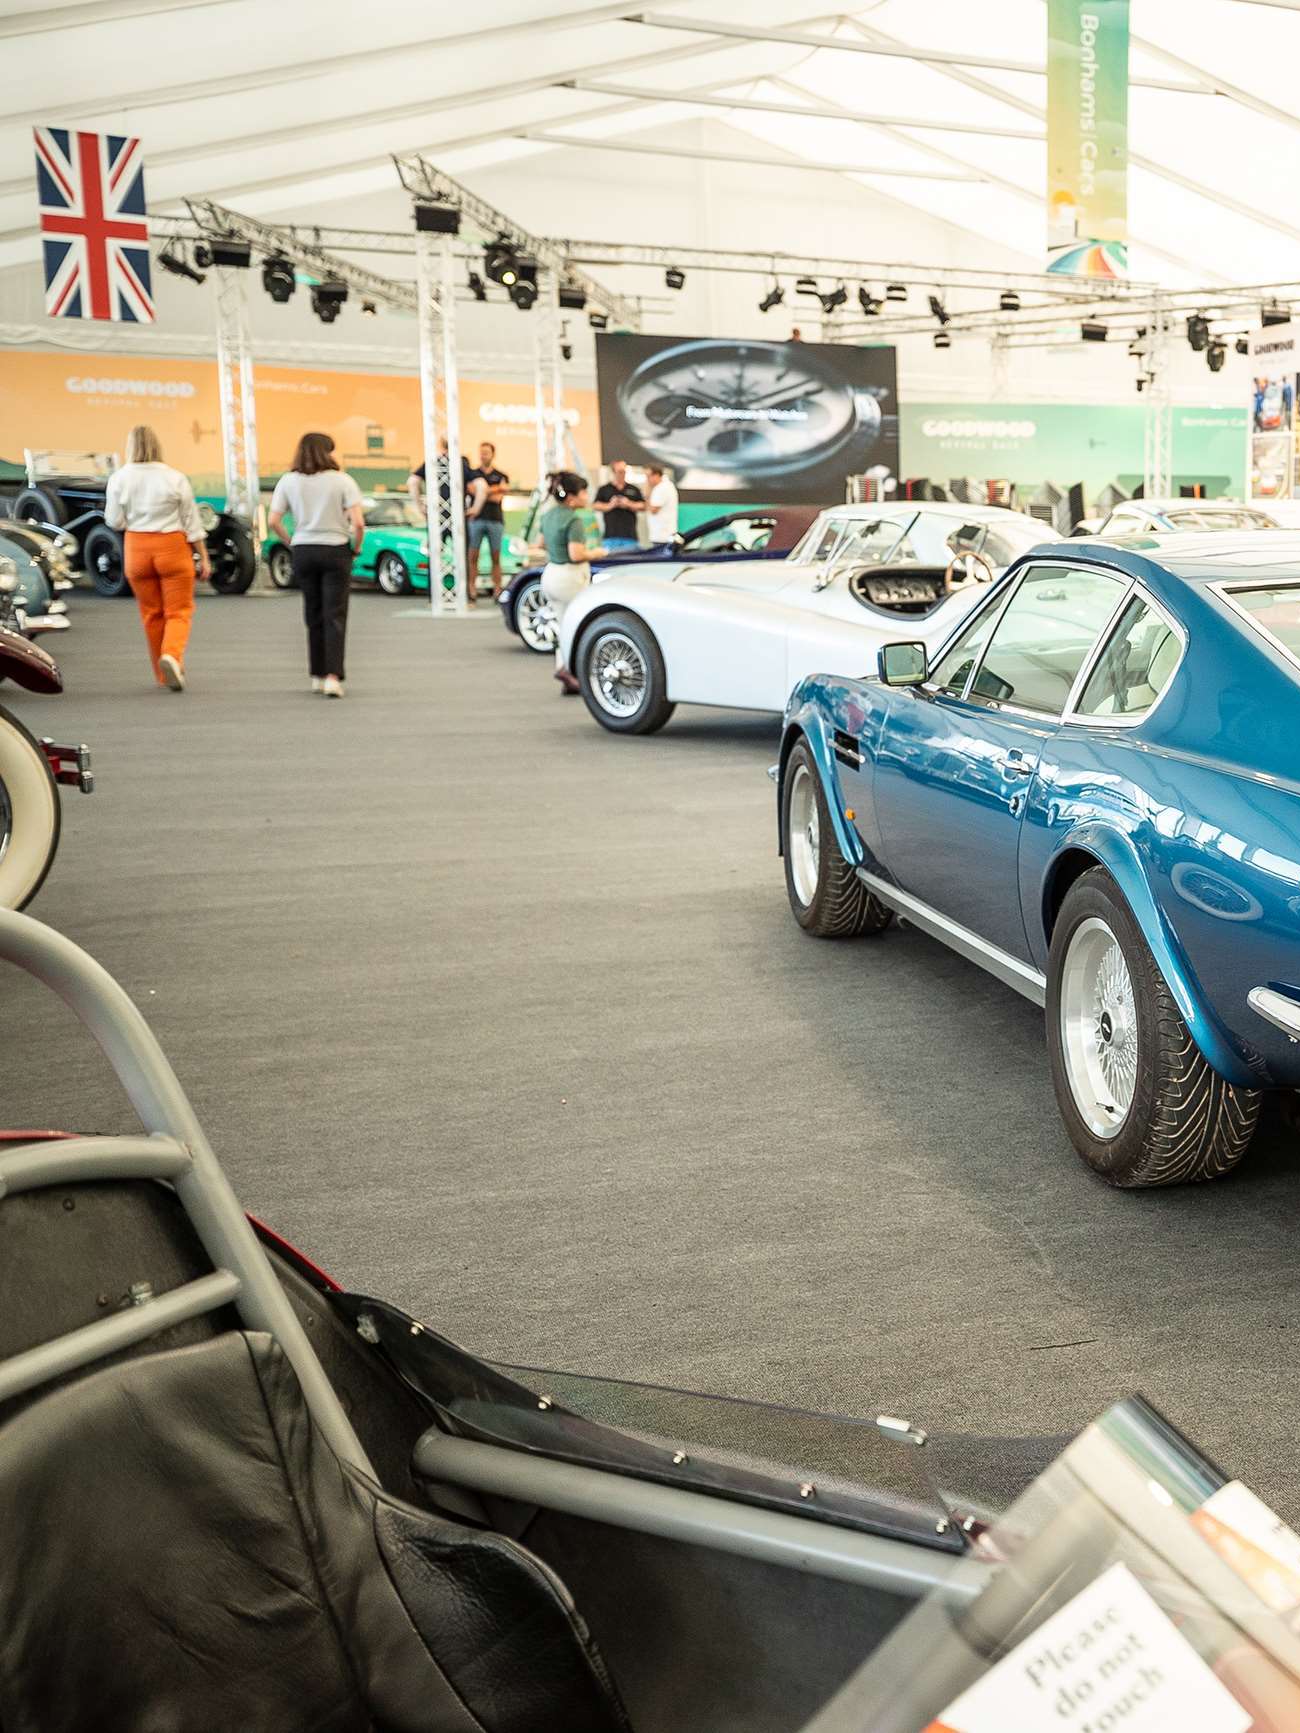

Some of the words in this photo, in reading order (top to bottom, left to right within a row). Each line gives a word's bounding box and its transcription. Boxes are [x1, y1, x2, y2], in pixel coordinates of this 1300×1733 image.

[1080, 14, 1099, 131] Bonhams
[1080, 141, 1098, 196] Cars
[65, 376, 196, 397] GOODWOOD
[922, 419, 1036, 438] GOODWOOD
[1025, 1606, 1125, 1690] Please
[1056, 1680, 1095, 1719] do
[1098, 1631, 1145, 1679] not
